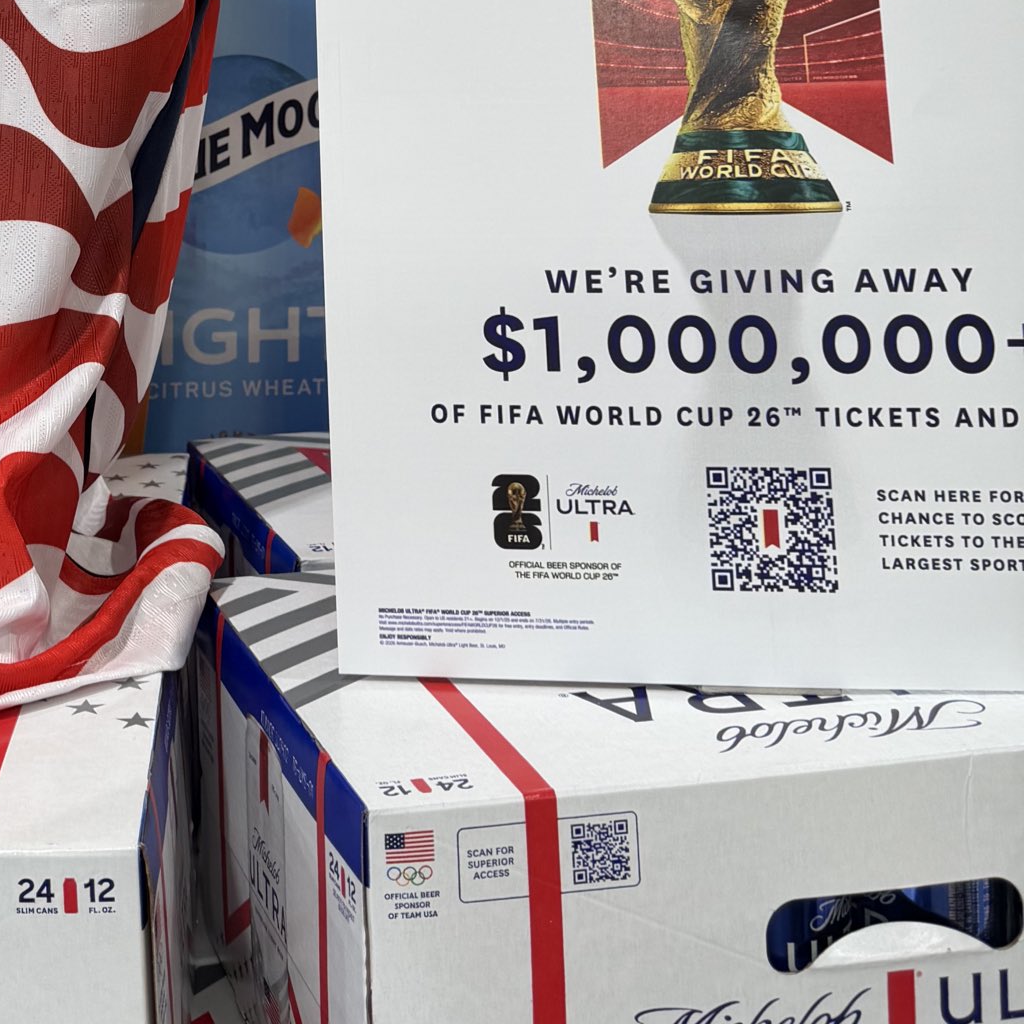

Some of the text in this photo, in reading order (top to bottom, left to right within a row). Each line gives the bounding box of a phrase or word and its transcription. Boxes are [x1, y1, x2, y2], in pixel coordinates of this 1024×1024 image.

[697, 149, 793, 165] FIFA
[680, 164, 762, 179] WORLD
[690, 268, 834, 294] GIVING
[854, 267, 973, 293] AWAY
[149, 378, 325, 399] CITRUS WHEAT
[431, 403, 465, 425] OF
[480, 404, 544, 426] FIFA
[556, 405, 662, 427] WORLD
[676, 406, 734, 428] CUP
[815, 407, 941, 428] TICKETS
[954, 407, 1019, 428] AND
[565, 483, 618, 496] Michelob
[876, 489, 1024, 503] SCAN HERE FOR
[556, 499, 634, 515] ULTRA
[878, 512, 955, 525] CHANCE
[961, 513, 985, 525] TO
[507, 534, 530, 543] FIFA
[879, 535, 1024, 549] TICKETS TO THE
[509, 561, 622, 570] OFFICIAL BEER SPONSOR OF
[881, 557, 963, 571] LARGEST
[515, 571, 531, 579] THE
[532, 571, 550, 579] FIFA
[551, 572, 581, 580] WORLD
[583, 572, 601, 580] CUP
[716, 699, 986, 754] Michelob
[379, 778, 474, 796] 24 12
[467, 846, 514, 858] SCAN FOR
[468, 857, 514, 869] SUPERIOR
[473, 869, 510, 880] ACCESS
[17, 878, 115, 903] 24 12
[384, 890, 440, 900] OFFICIAL BEER
[394, 901, 430, 910] SPONSOR
[388, 909, 438, 920] OF TEAM USA
